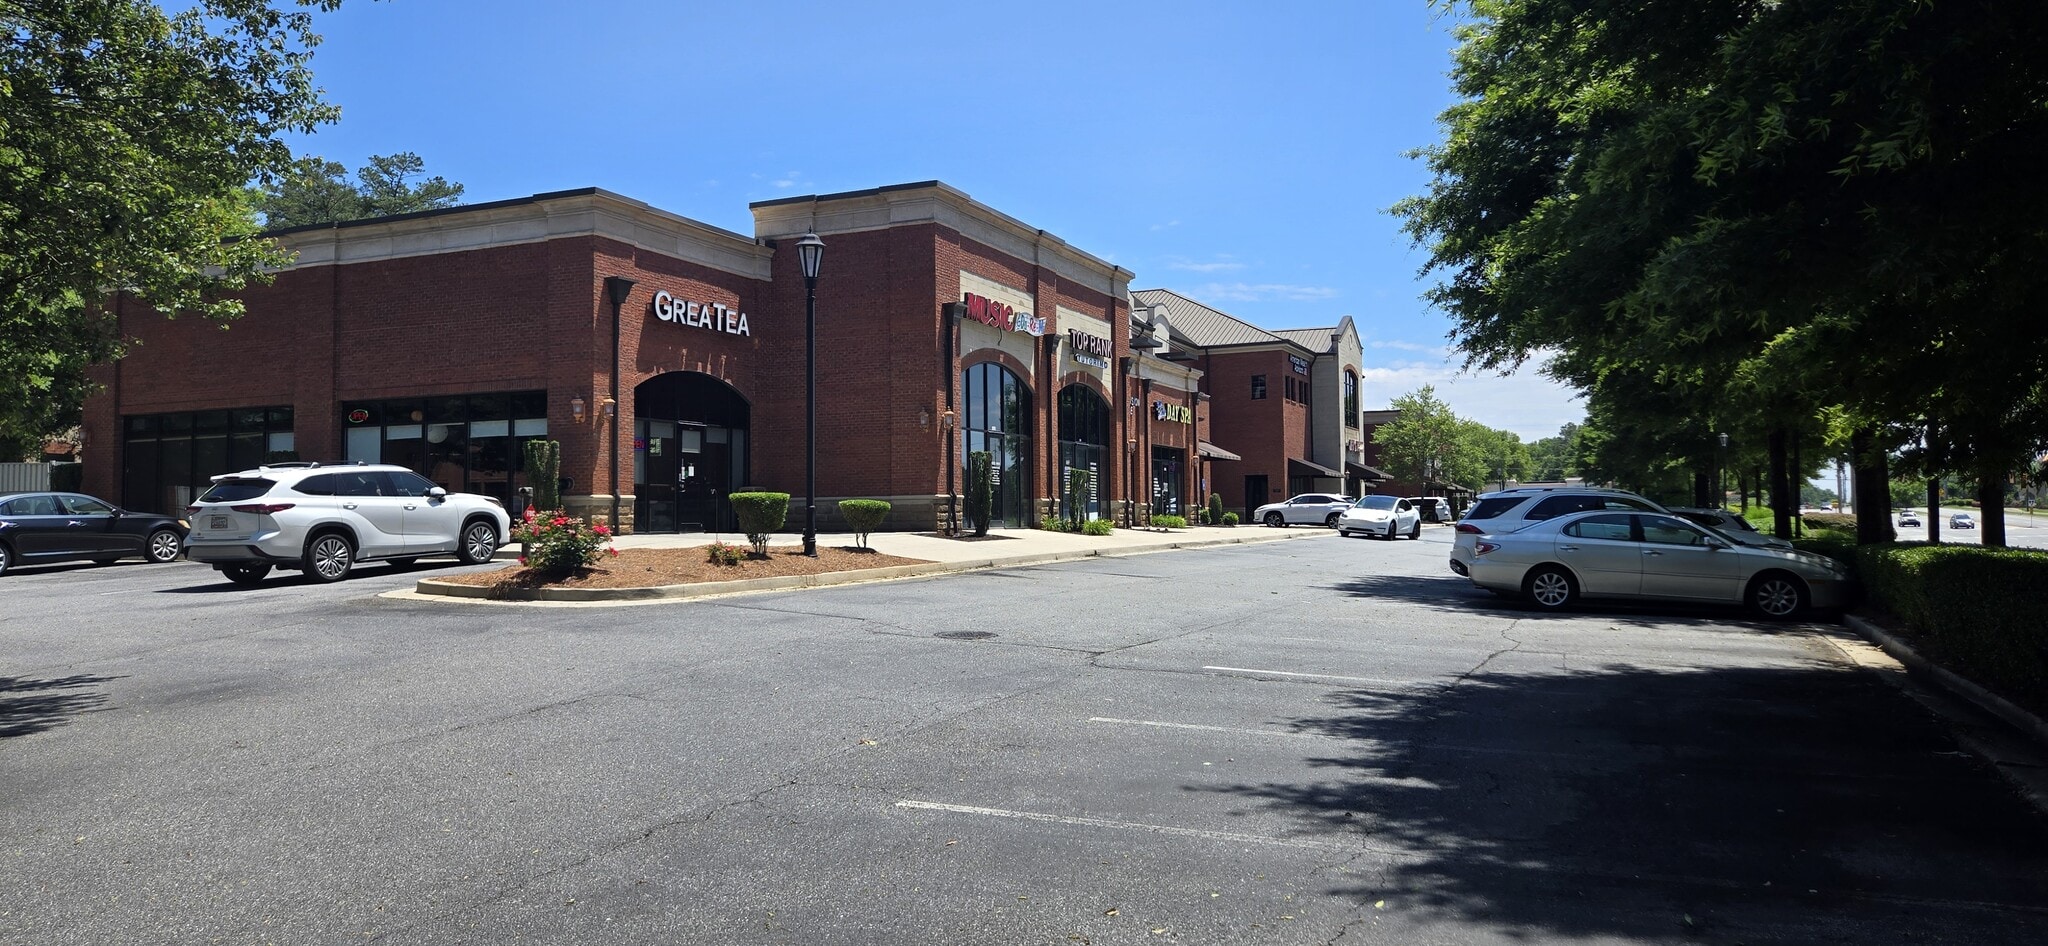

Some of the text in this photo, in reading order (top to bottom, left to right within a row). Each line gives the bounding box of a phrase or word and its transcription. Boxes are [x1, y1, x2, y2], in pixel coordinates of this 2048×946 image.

[966, 292, 1014, 332] MUSIC
[1070, 329, 1113, 359] TOP RANK
[1166, 403, 1192, 425] DAY SPA
[634, 439, 645, 449] PEN
